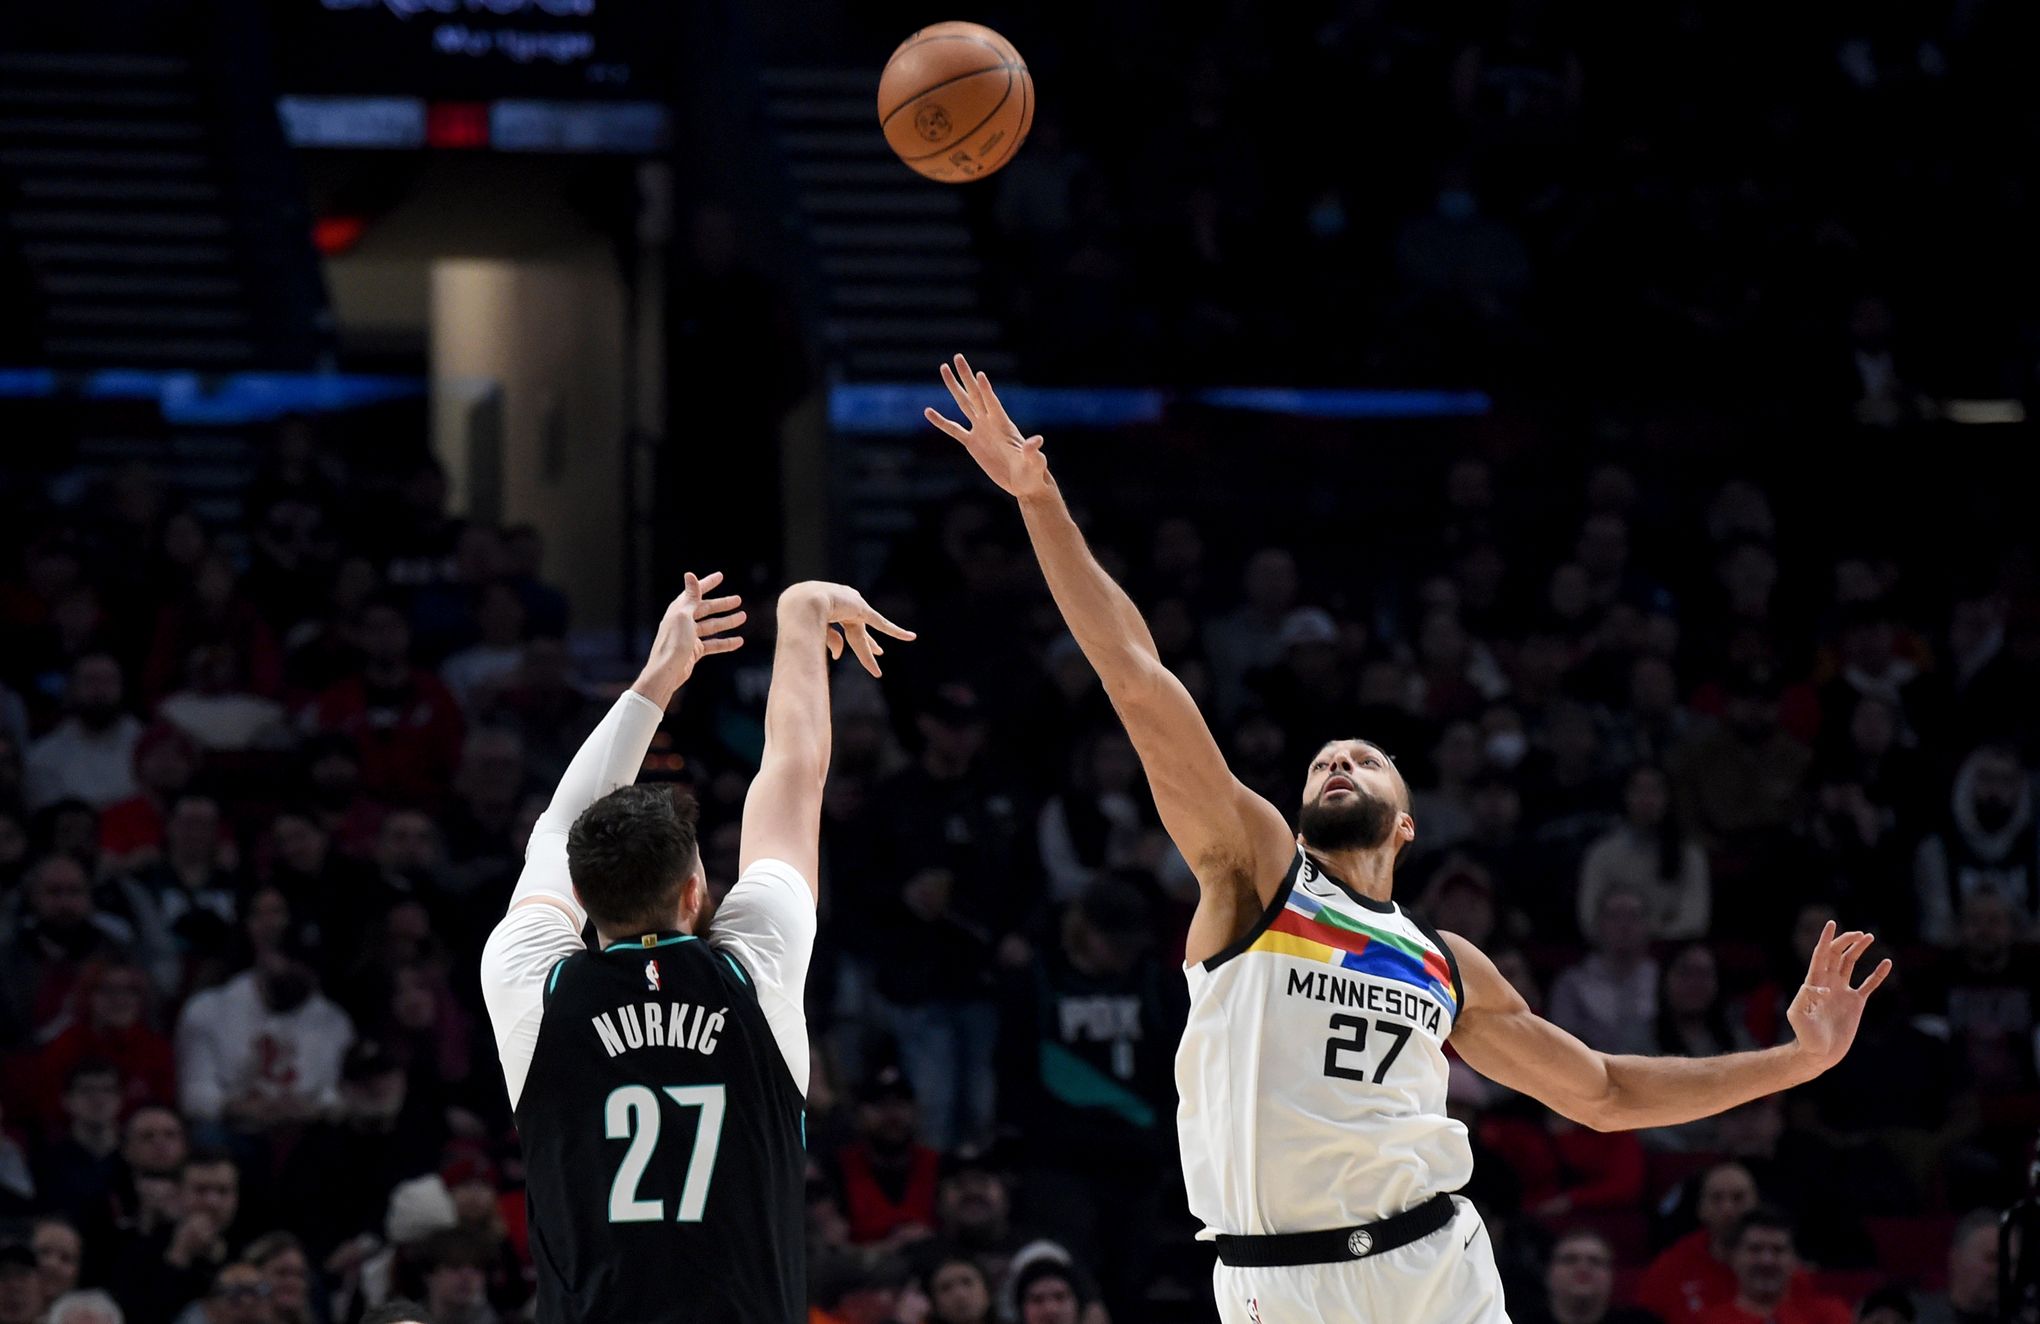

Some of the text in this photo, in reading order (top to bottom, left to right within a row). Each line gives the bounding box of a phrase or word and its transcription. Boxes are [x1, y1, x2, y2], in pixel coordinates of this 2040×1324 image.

[591, 1002, 729, 1058] NURKIĆ
[1287, 968, 1442, 1035] MINNESOTA
[1323, 1013, 1413, 1085] 27
[605, 1084, 726, 1223] 27
